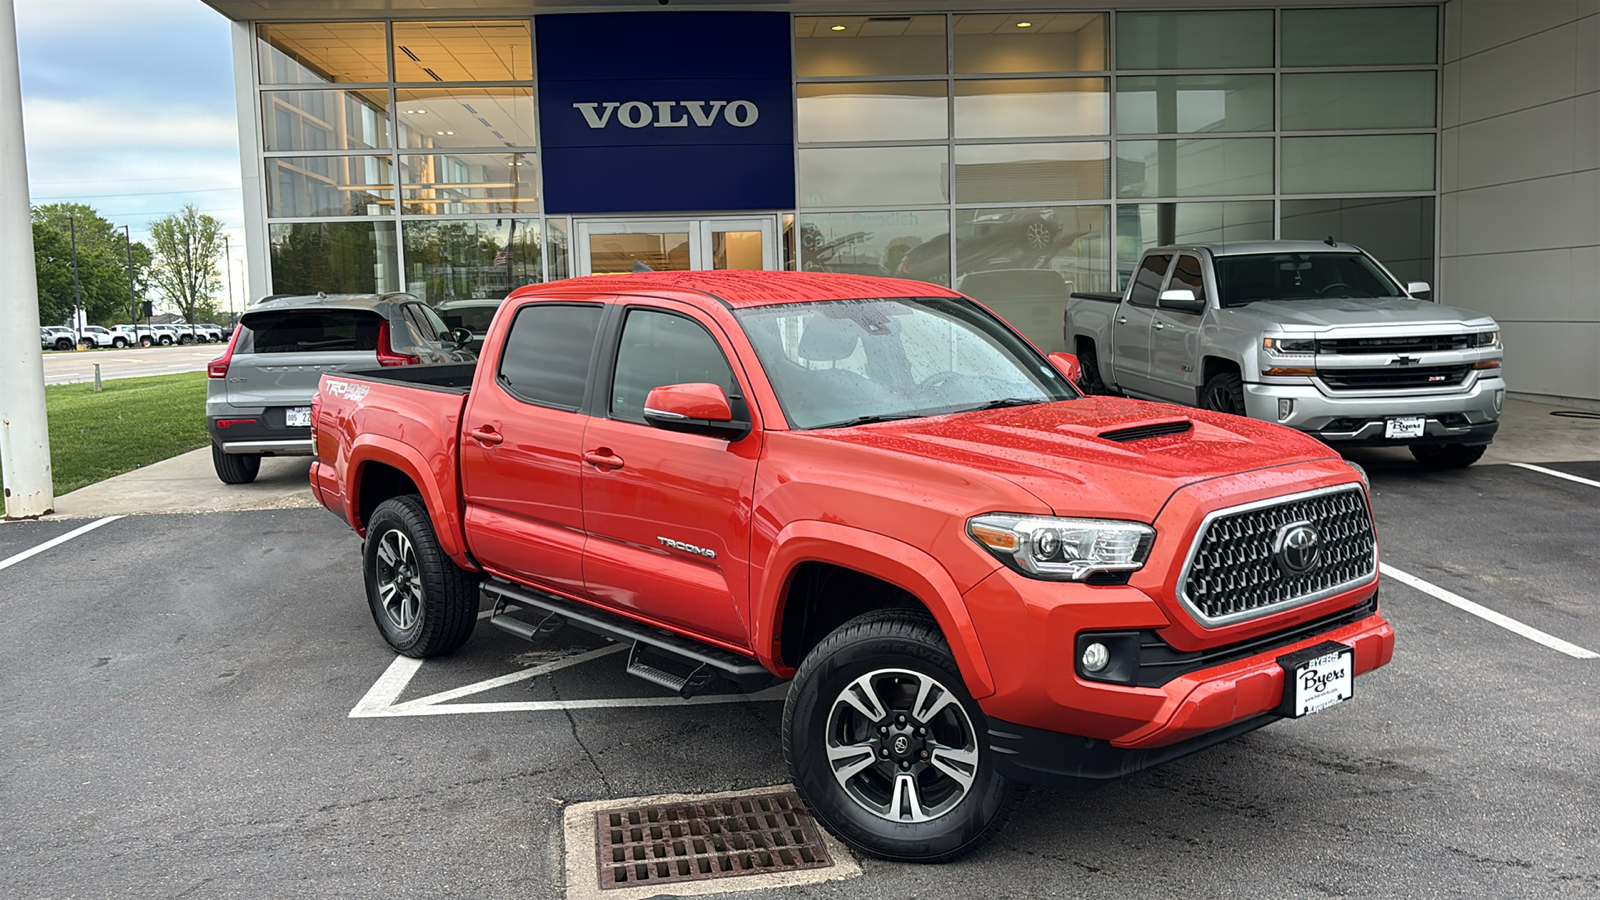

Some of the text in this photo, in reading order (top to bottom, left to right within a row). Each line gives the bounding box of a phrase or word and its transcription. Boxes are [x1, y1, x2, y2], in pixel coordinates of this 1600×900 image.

[572, 99, 759, 129] VOLVO
[326, 380, 348, 396] TRD
[343, 393, 366, 402] SPORT
[657, 535, 716, 559] TACOMA
[1309, 652, 1339, 668] BYERS
[1299, 667, 1345, 693] Byers
